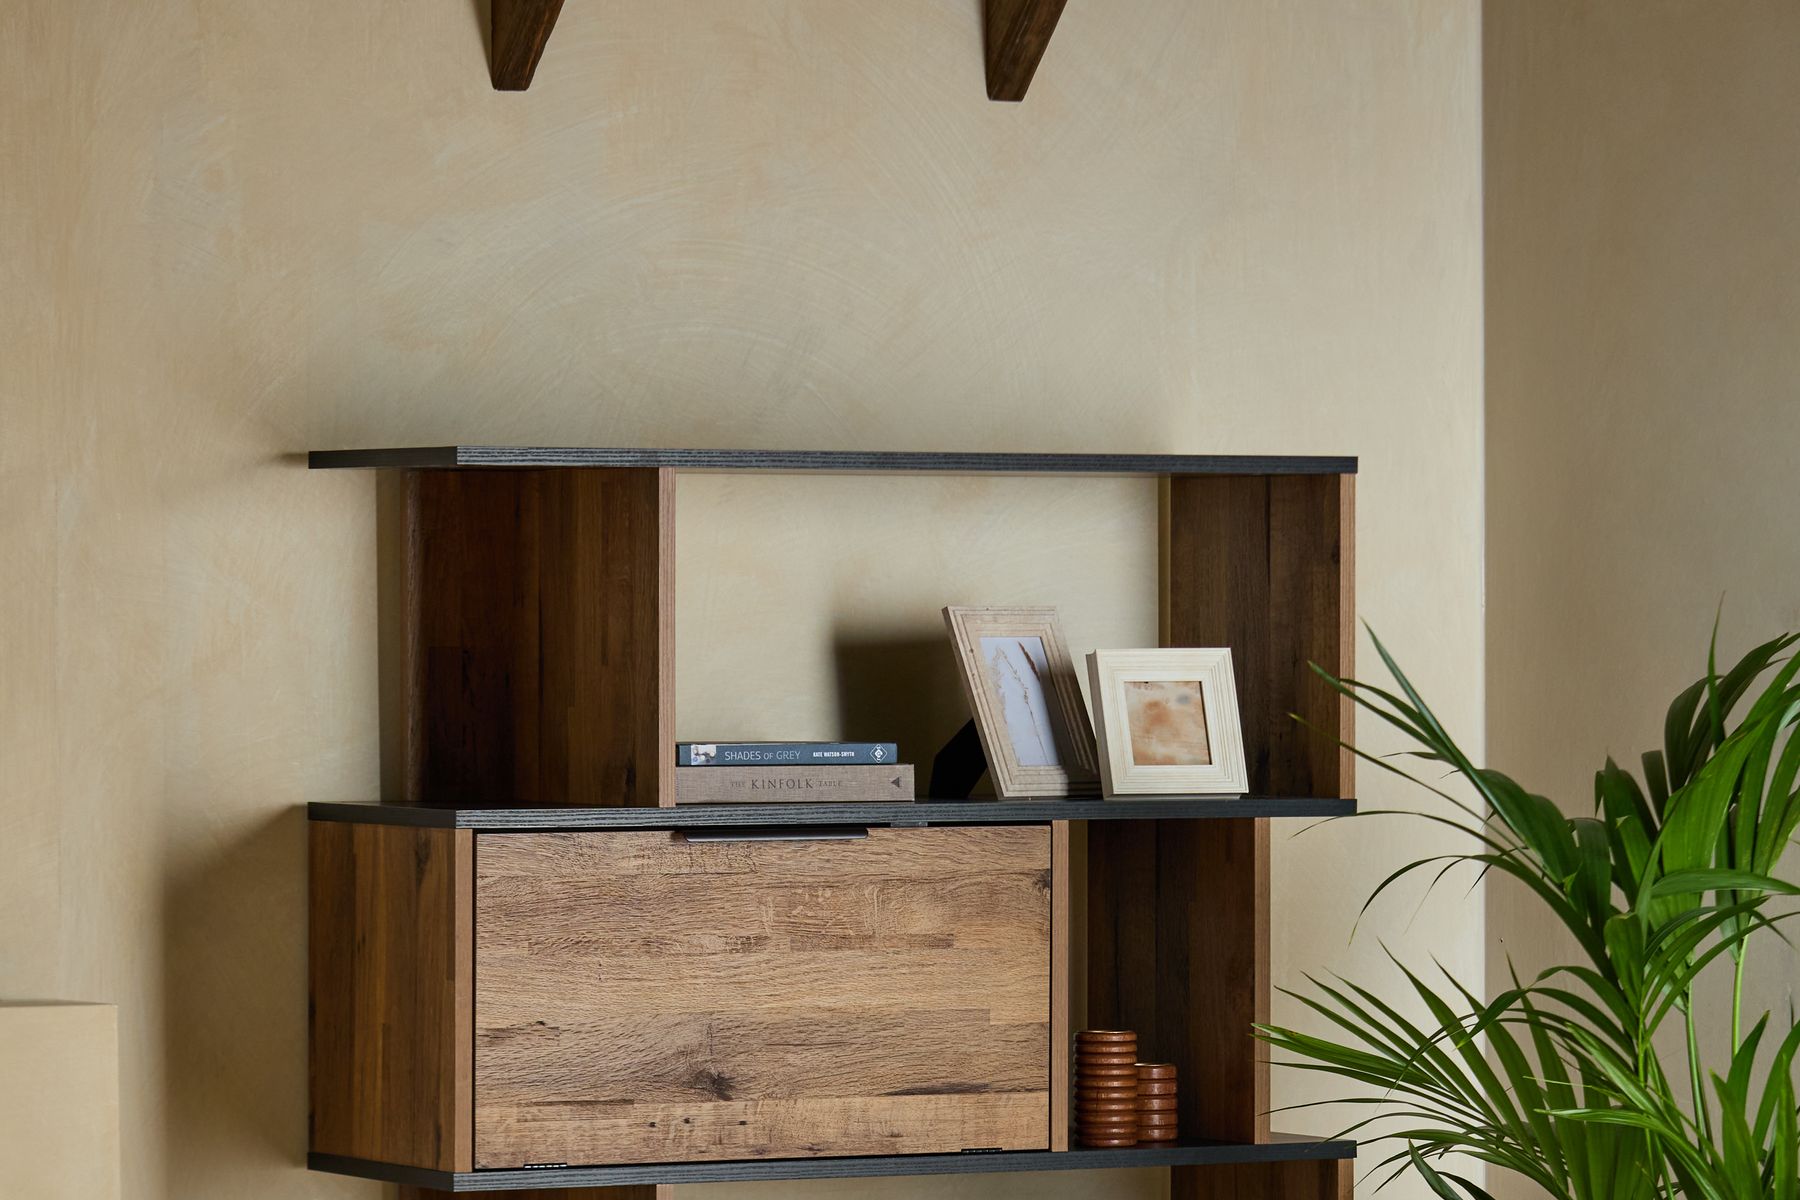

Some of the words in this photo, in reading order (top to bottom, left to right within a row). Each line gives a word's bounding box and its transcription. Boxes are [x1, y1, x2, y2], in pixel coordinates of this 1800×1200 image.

[724, 750, 760, 760] SHADES
[776, 750, 801, 760] GREY
[751, 778, 813, 789] KINFOLK
